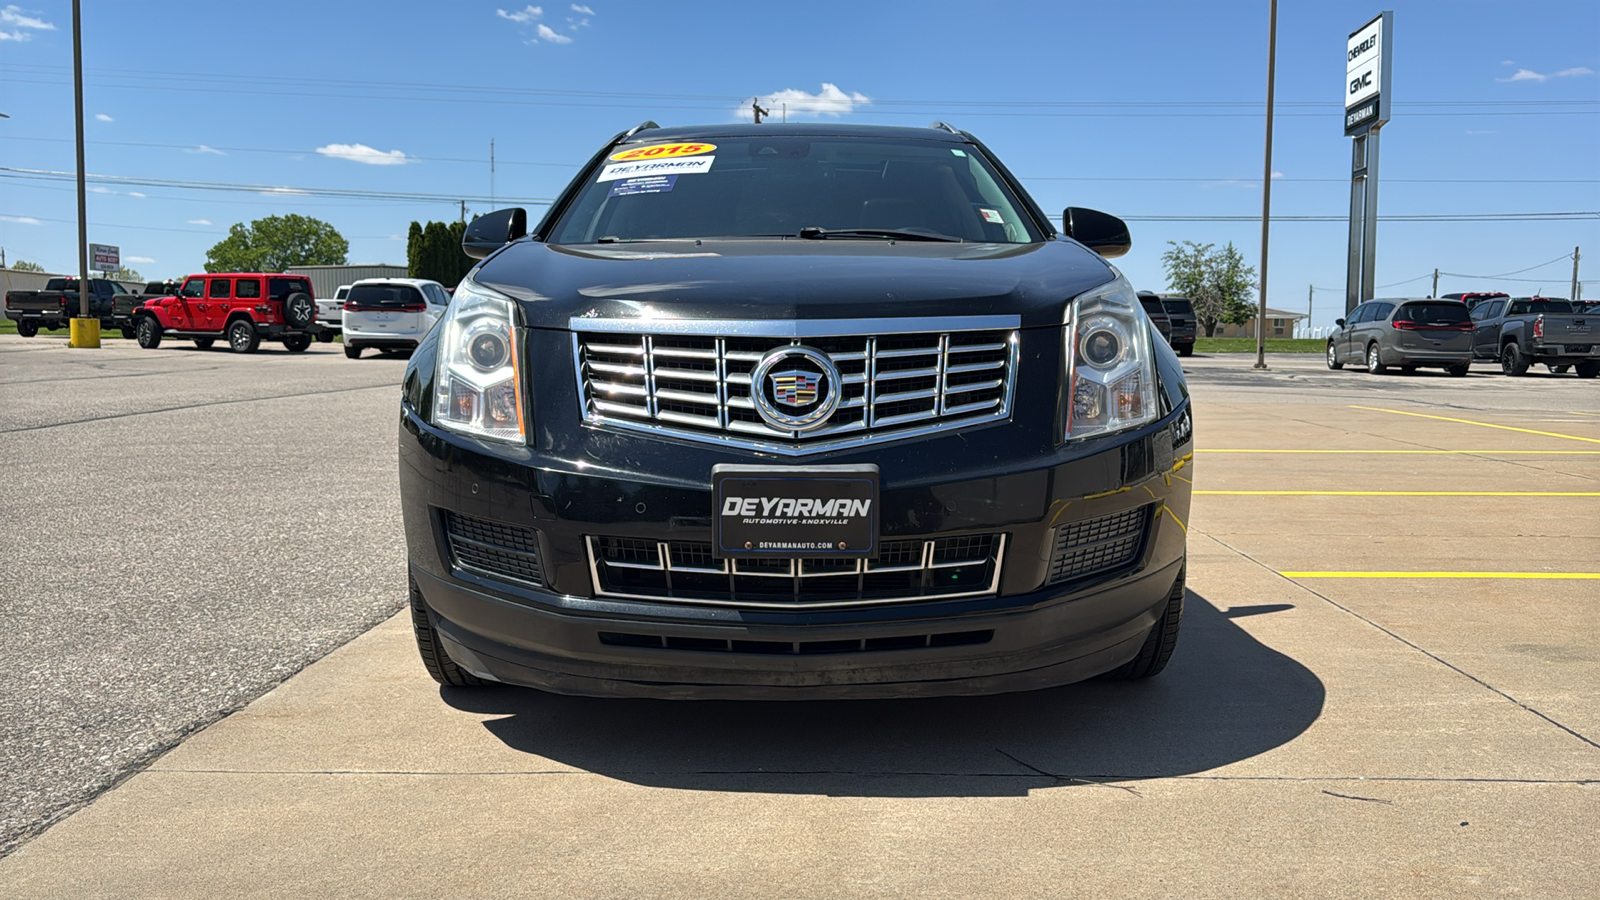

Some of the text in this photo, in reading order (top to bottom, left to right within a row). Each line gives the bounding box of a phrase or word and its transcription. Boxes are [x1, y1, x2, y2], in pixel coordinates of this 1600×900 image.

[1348, 34, 1377, 62] CHEVROLET
[1350, 70, 1372, 95] GMC
[1347, 105, 1373, 126] DEYARMAN
[619, 144, 706, 159] 2015
[609, 160, 706, 174] DEYARMAN
[721, 496, 872, 517] DEYARMAN
[759, 541, 833, 549] DEYARMANAUTO.COM
